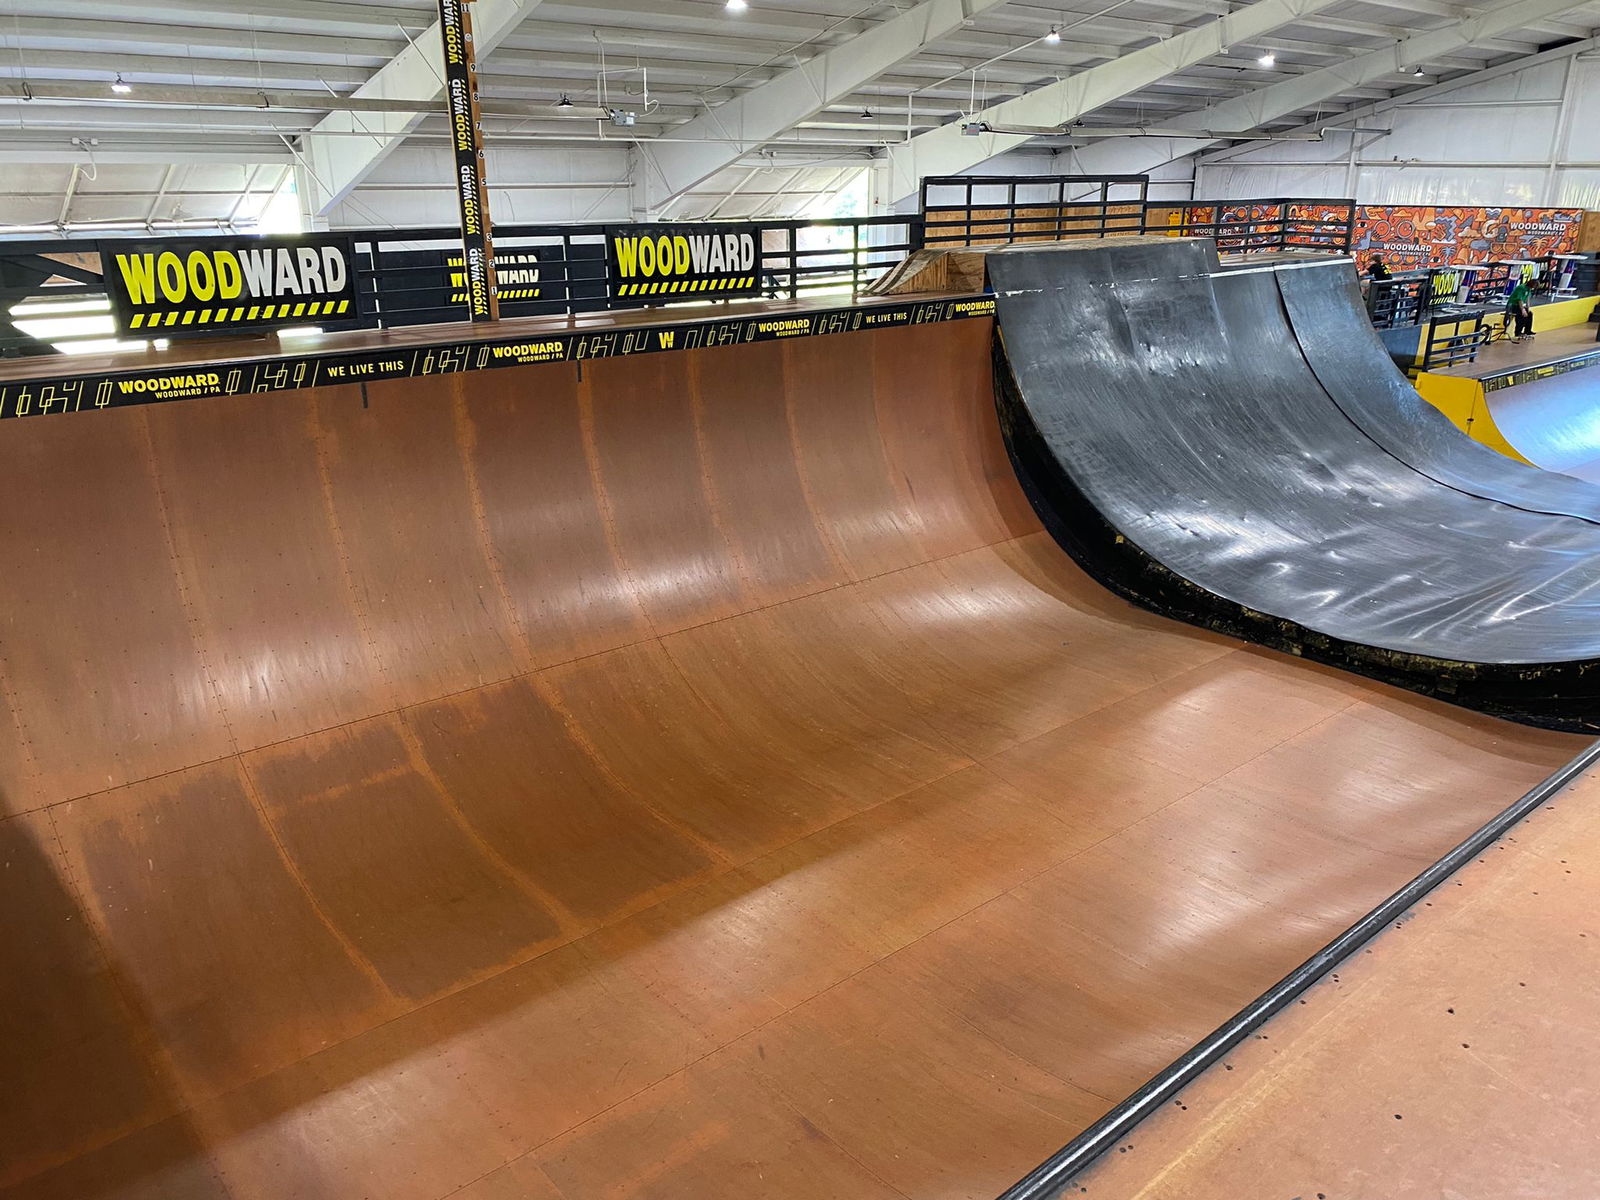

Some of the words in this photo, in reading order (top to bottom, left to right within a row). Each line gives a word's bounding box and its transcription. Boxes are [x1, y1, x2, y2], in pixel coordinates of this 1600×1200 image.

[462, 4, 470, 12] 11
[443, 0, 458, 64] WOODWAR
[470, 64, 476, 72] 9
[474, 93, 478, 101] 8
[452, 78, 468, 151] WOODWARD
[476, 122, 480, 130] 7
[460, 165, 476, 235] WOODWARD
[1510, 222, 1566, 230] WOODWARD
[486, 233, 492, 241] 3
[1383, 243, 1432, 252] WOODWARD
[614, 234, 754, 278] WOODWARD
[489, 260, 494, 268] 2
[116, 246, 346, 304] WOODWARD
[469, 248, 484, 315] WOODWARD
[956, 300, 994, 312] WOODWARD
[866, 315, 876, 324] WE
[878, 314, 891, 322] LIVE
[893, 312, 907, 320] THIS
[758, 319, 810, 332] WOODWARD
[492, 342, 562, 358] WOODWARD
[518, 354, 550, 362] WOODWARD
[328, 366, 346, 378] WE
[350, 364, 374, 375] LIVE
[378, 360, 404, 372] THIS
[118, 373, 219, 394] WOODWARD
[155, 389, 202, 399] WOODWARD
